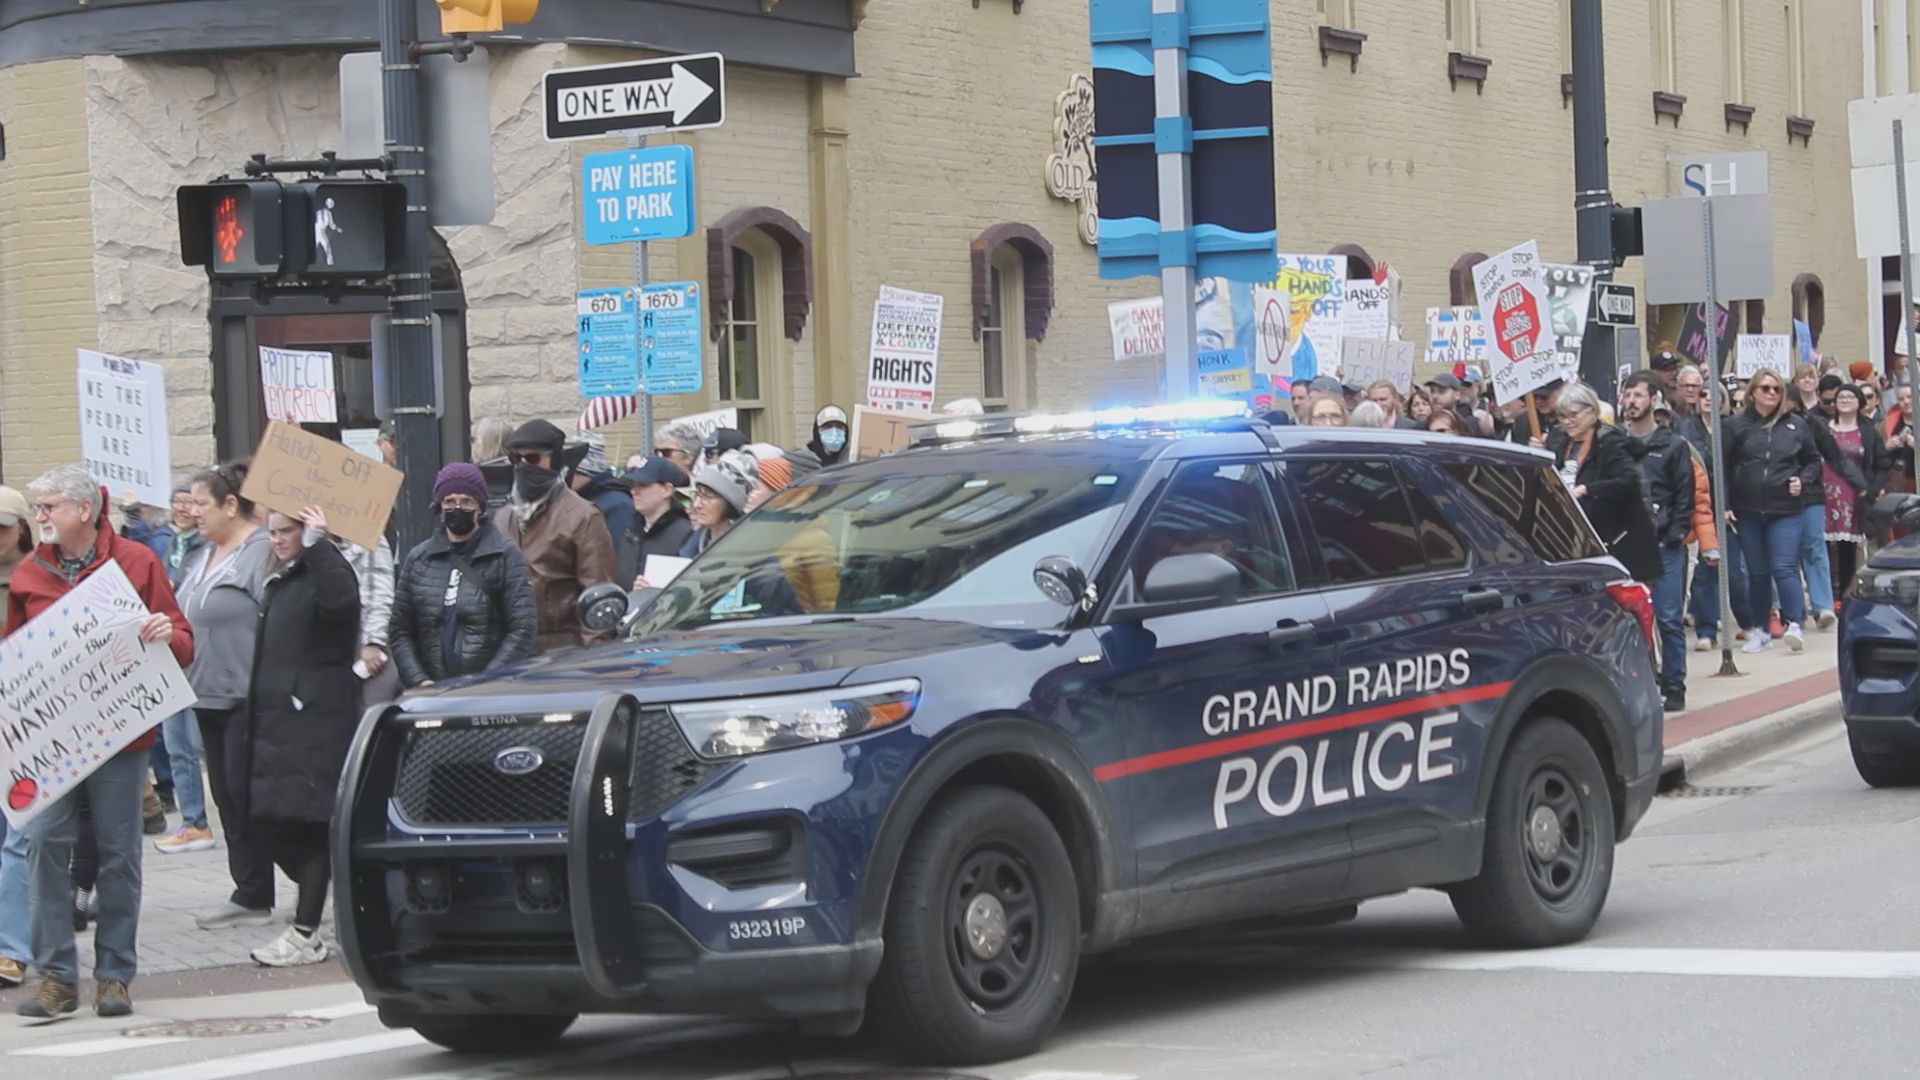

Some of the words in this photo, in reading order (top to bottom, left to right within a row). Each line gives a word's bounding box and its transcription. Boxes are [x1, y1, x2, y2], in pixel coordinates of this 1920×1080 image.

[564, 88, 614, 117] ONE
[624, 82, 673, 111] WAY
[591, 165, 623, 193] PAY
[629, 160, 677, 189] HERE
[1053, 162, 1084, 190] OLD
[597, 197, 619, 223] TO
[626, 192, 673, 220] PARK
[1297, 256, 1336, 275] YOUR
[1512, 253, 1533, 264] STOP
[1480, 264, 1498, 289] STOP
[1541, 268, 1589, 284] VOLT
[1289, 278, 1342, 297] HANDS
[1500, 287, 1521, 310] STOP
[591, 298, 616, 313] 670
[646, 294, 678, 308] 1670
[1312, 299, 1343, 318] OFF
[1357, 300, 1380, 310] OFF
[1452, 309, 1472, 321] NO
[877, 322, 936, 333] DEFEND
[1437, 325, 1485, 338] WARS
[1357, 341, 1407, 363] FUK
[1450, 336, 1471, 350] NO
[1741, 336, 1767, 349] HANDS
[1198, 354, 1231, 368] HONK
[1532, 349, 1553, 363] STOP
[1756, 350, 1775, 361] OUR
[263, 348, 330, 388] PROTECT
[872, 357, 933, 385] RIGHTS
[1496, 363, 1514, 384] STOP
[86, 381, 103, 399] WE
[115, 386, 142, 406] THE
[85, 408, 143, 435] PEOPLE
[102, 435, 130, 456] ARE
[268, 425, 321, 465] Hands
[85, 458, 151, 487] POWERFUL
[308, 466, 333, 488] the
[50, 640, 71, 659] are
[73, 614, 99, 638] Red
[8, 676, 56, 712] Violets
[60, 654, 82, 673] are
[85, 631, 115, 656] Blue
[90, 680, 111, 702] our
[1201, 675, 1336, 736] GRAND
[1347, 647, 1471, 706] RAPIDS
[1, 688, 79, 751] HANDS
[78, 656, 112, 694] OFF
[9, 739, 73, 784] MAGA
[98, 681, 149, 722] talking
[1212, 711, 1459, 830] POLICE
[729, 917, 806, 940] 332319P
